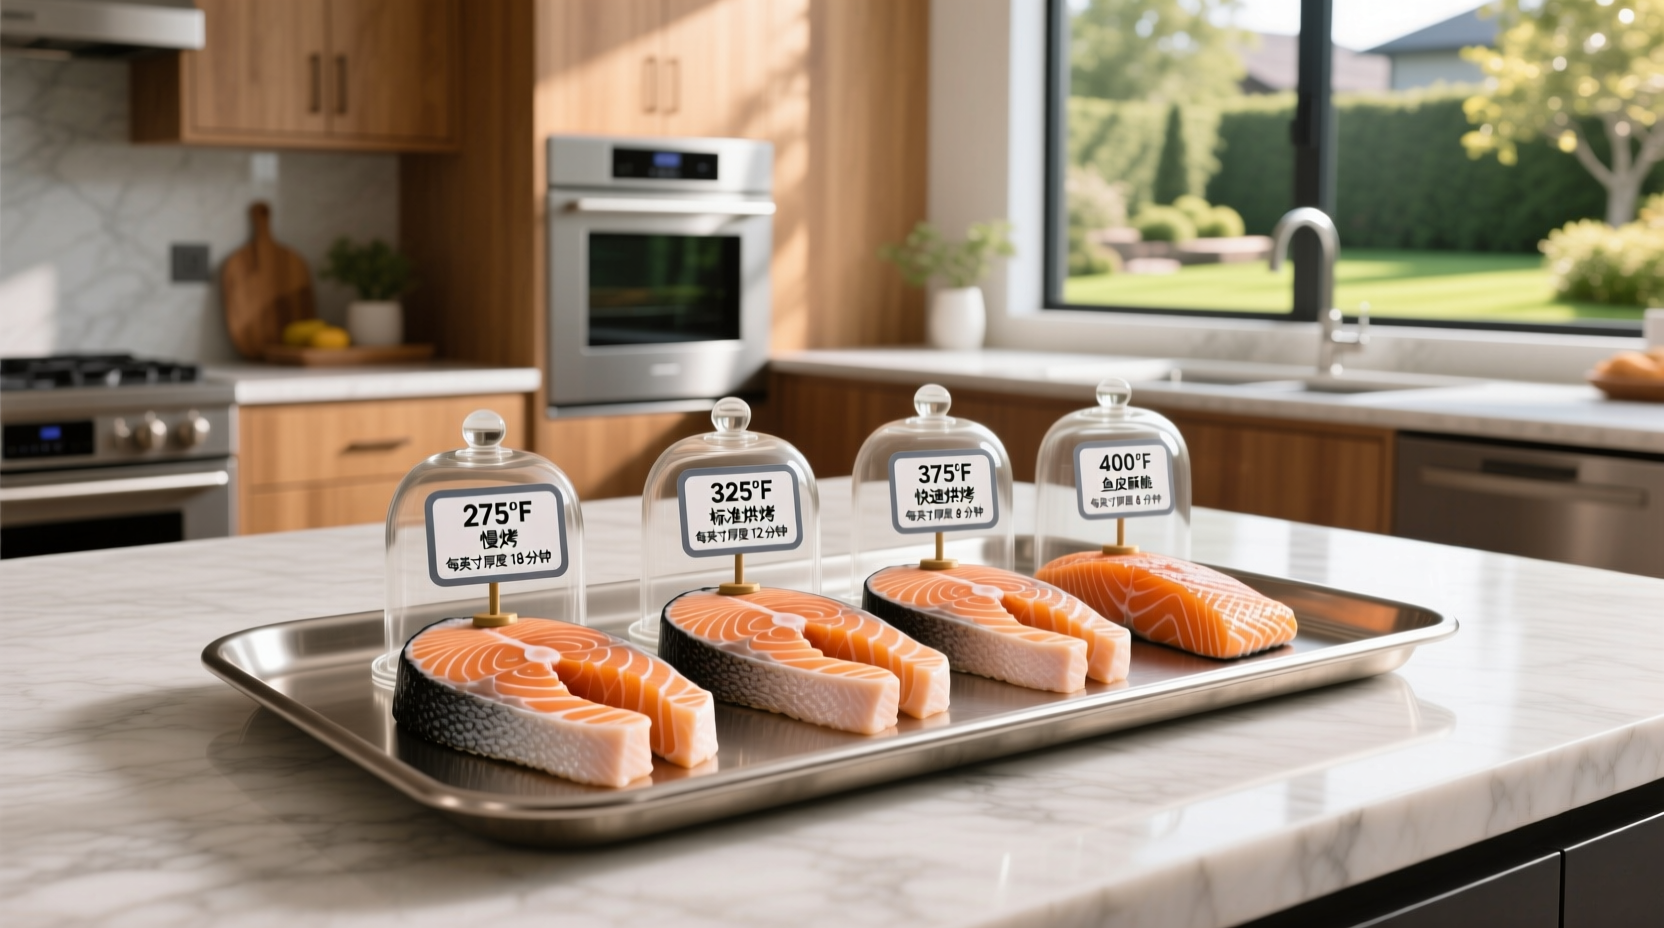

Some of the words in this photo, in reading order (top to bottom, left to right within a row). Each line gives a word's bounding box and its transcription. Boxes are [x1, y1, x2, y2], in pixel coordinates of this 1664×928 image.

[918, 463, 972, 484] 375°F
[1099, 453, 1151, 472] 400°F
[710, 480, 772, 503] 325°F
[463, 500, 532, 528] 275°F
